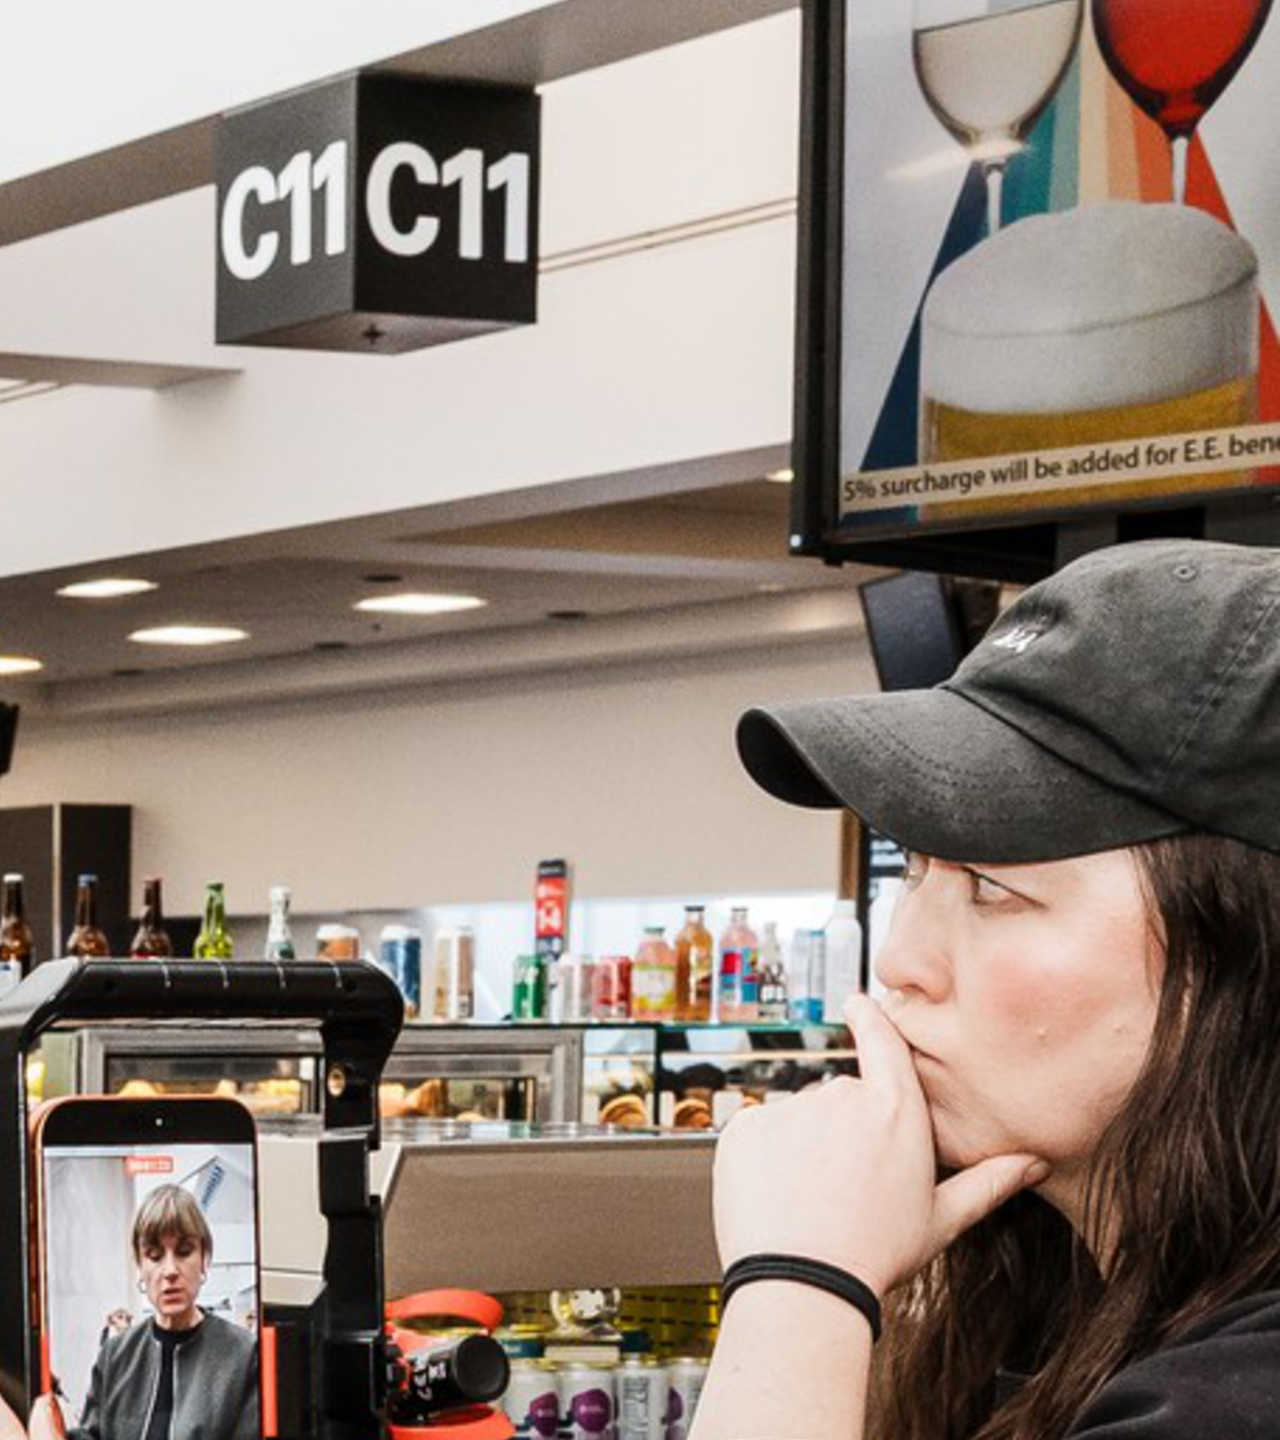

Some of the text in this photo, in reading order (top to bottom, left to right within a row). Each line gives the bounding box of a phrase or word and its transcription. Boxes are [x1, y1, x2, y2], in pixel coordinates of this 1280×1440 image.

[221, 139, 348, 281] C11
[365, 141, 531, 264] C11
[843, 432, 1280, 502] 5% surcharge will be added for E.E. ben
